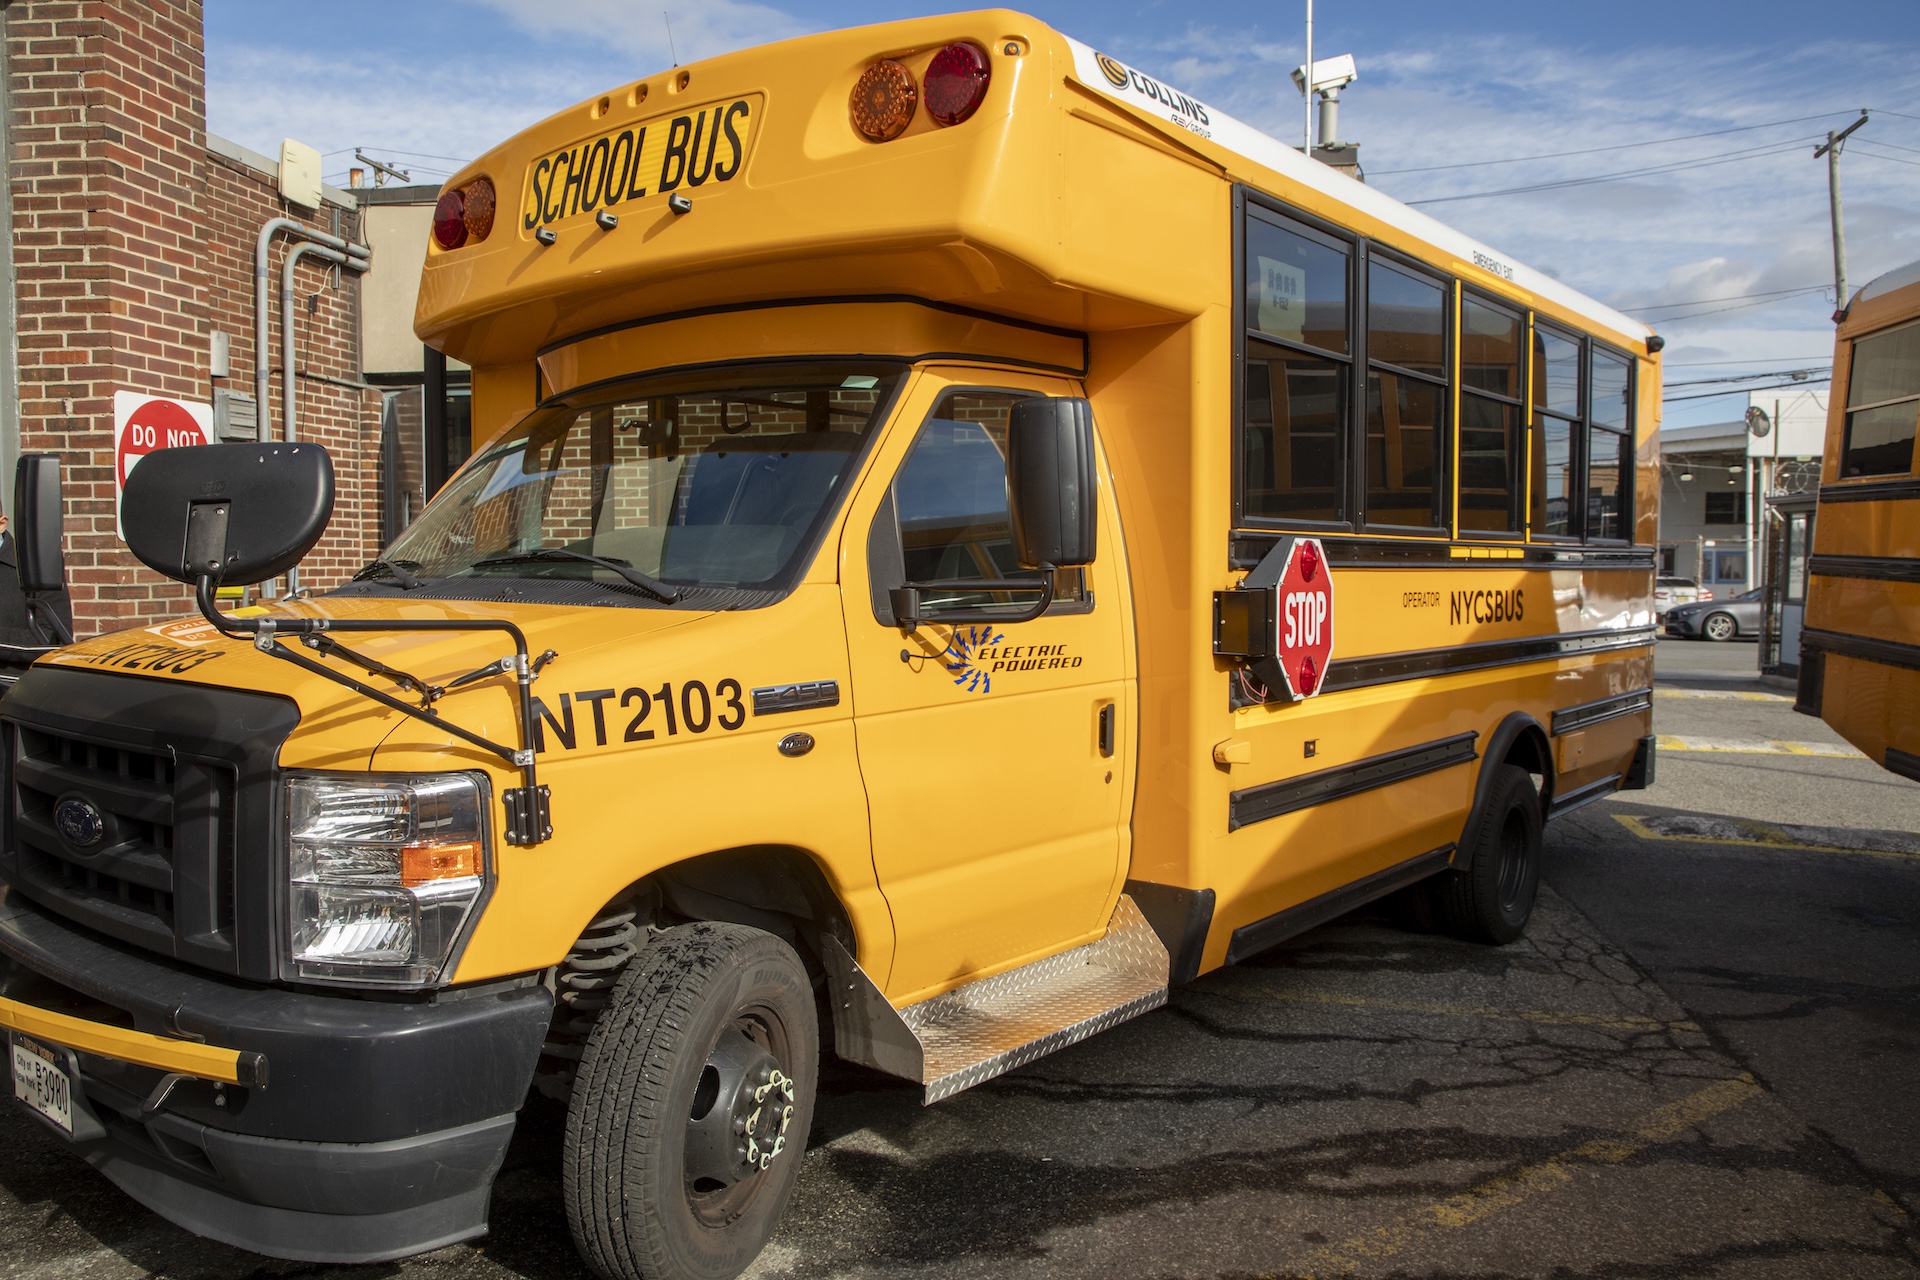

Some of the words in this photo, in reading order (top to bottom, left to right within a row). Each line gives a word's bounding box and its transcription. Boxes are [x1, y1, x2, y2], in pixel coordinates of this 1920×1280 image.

[1128, 69, 1209, 126] COLLINS
[1170, 114, 1193, 128] REV
[1191, 123, 1211, 139] GROUP
[525, 127, 647, 229] SCHOOL
[658, 100, 749, 194] BUS
[132, 424, 156, 448] DO
[167, 428, 199, 448] NOT
[1284, 591, 1327, 649] STOP
[1402, 591, 1440, 608] OPERATOR
[1450, 589, 1524, 625] NYCSBUS
[978, 644, 1067, 660] ELECTRIC
[992, 656, 1082, 672] POWERED
[531, 678, 746, 753] NT2103
[16, 1054, 26, 1070] City
[26, 1061, 32, 1072] of
[24, 1037, 39, 1054] NEW
[39, 1046, 55, 1065] YORK
[15, 1069, 25, 1084] New
[25, 1074, 36, 1091] York
